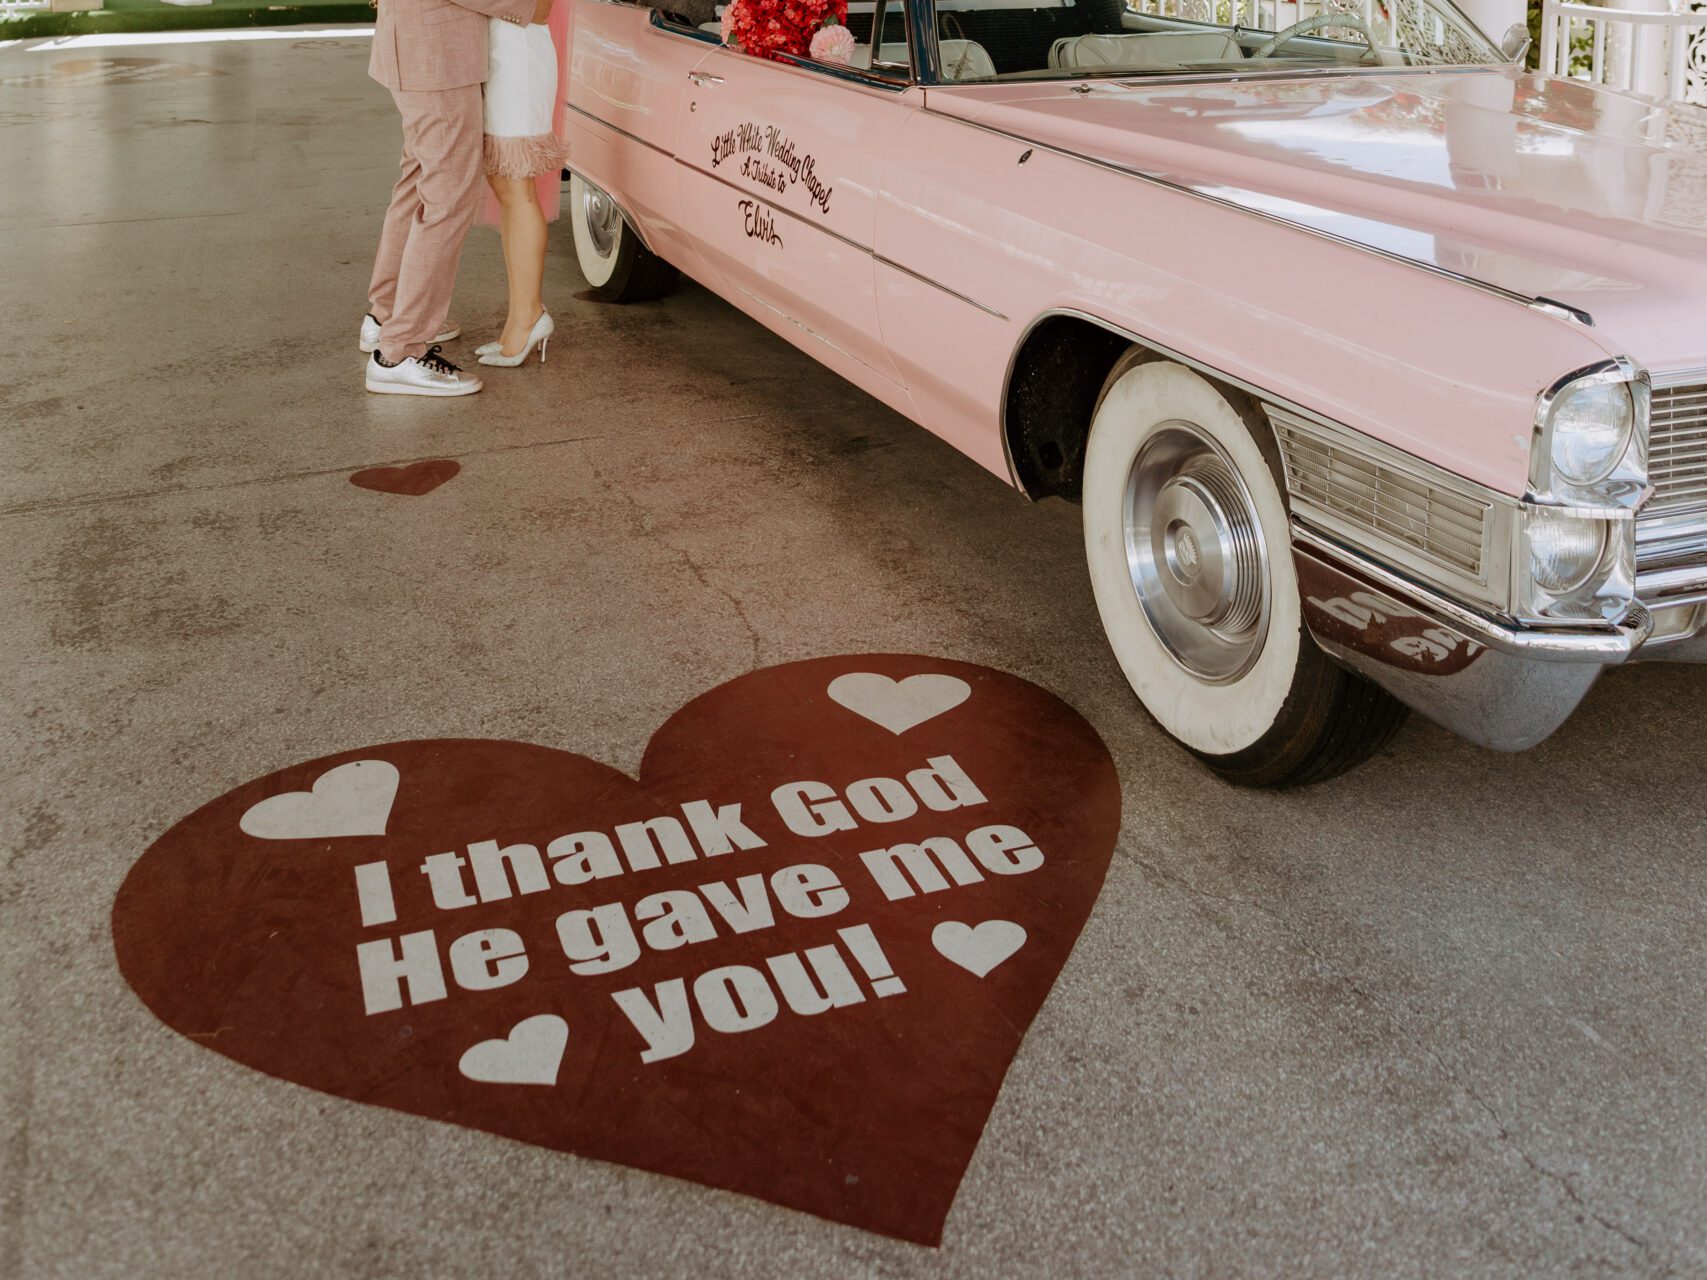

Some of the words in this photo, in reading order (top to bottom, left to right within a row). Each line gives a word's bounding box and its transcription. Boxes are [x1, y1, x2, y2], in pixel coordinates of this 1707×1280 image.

[710, 129, 736, 168] Little
[737, 122, 763, 153] White
[765, 125, 802, 184] Wedding
[801, 154, 833, 214] Chapel
[738, 200, 784, 250] Elvis
[740, 155, 751, 178] A
[751, 160, 776, 189] Tribute
[777, 171, 787, 194] to
[354, 860, 398, 928] I
[420, 798, 768, 911] thank
[770, 754, 990, 838] God
[356, 927, 530, 1016] He
[555, 862, 851, 976] gave
[857, 824, 1046, 902] me
[610, 923, 908, 1064] you!
